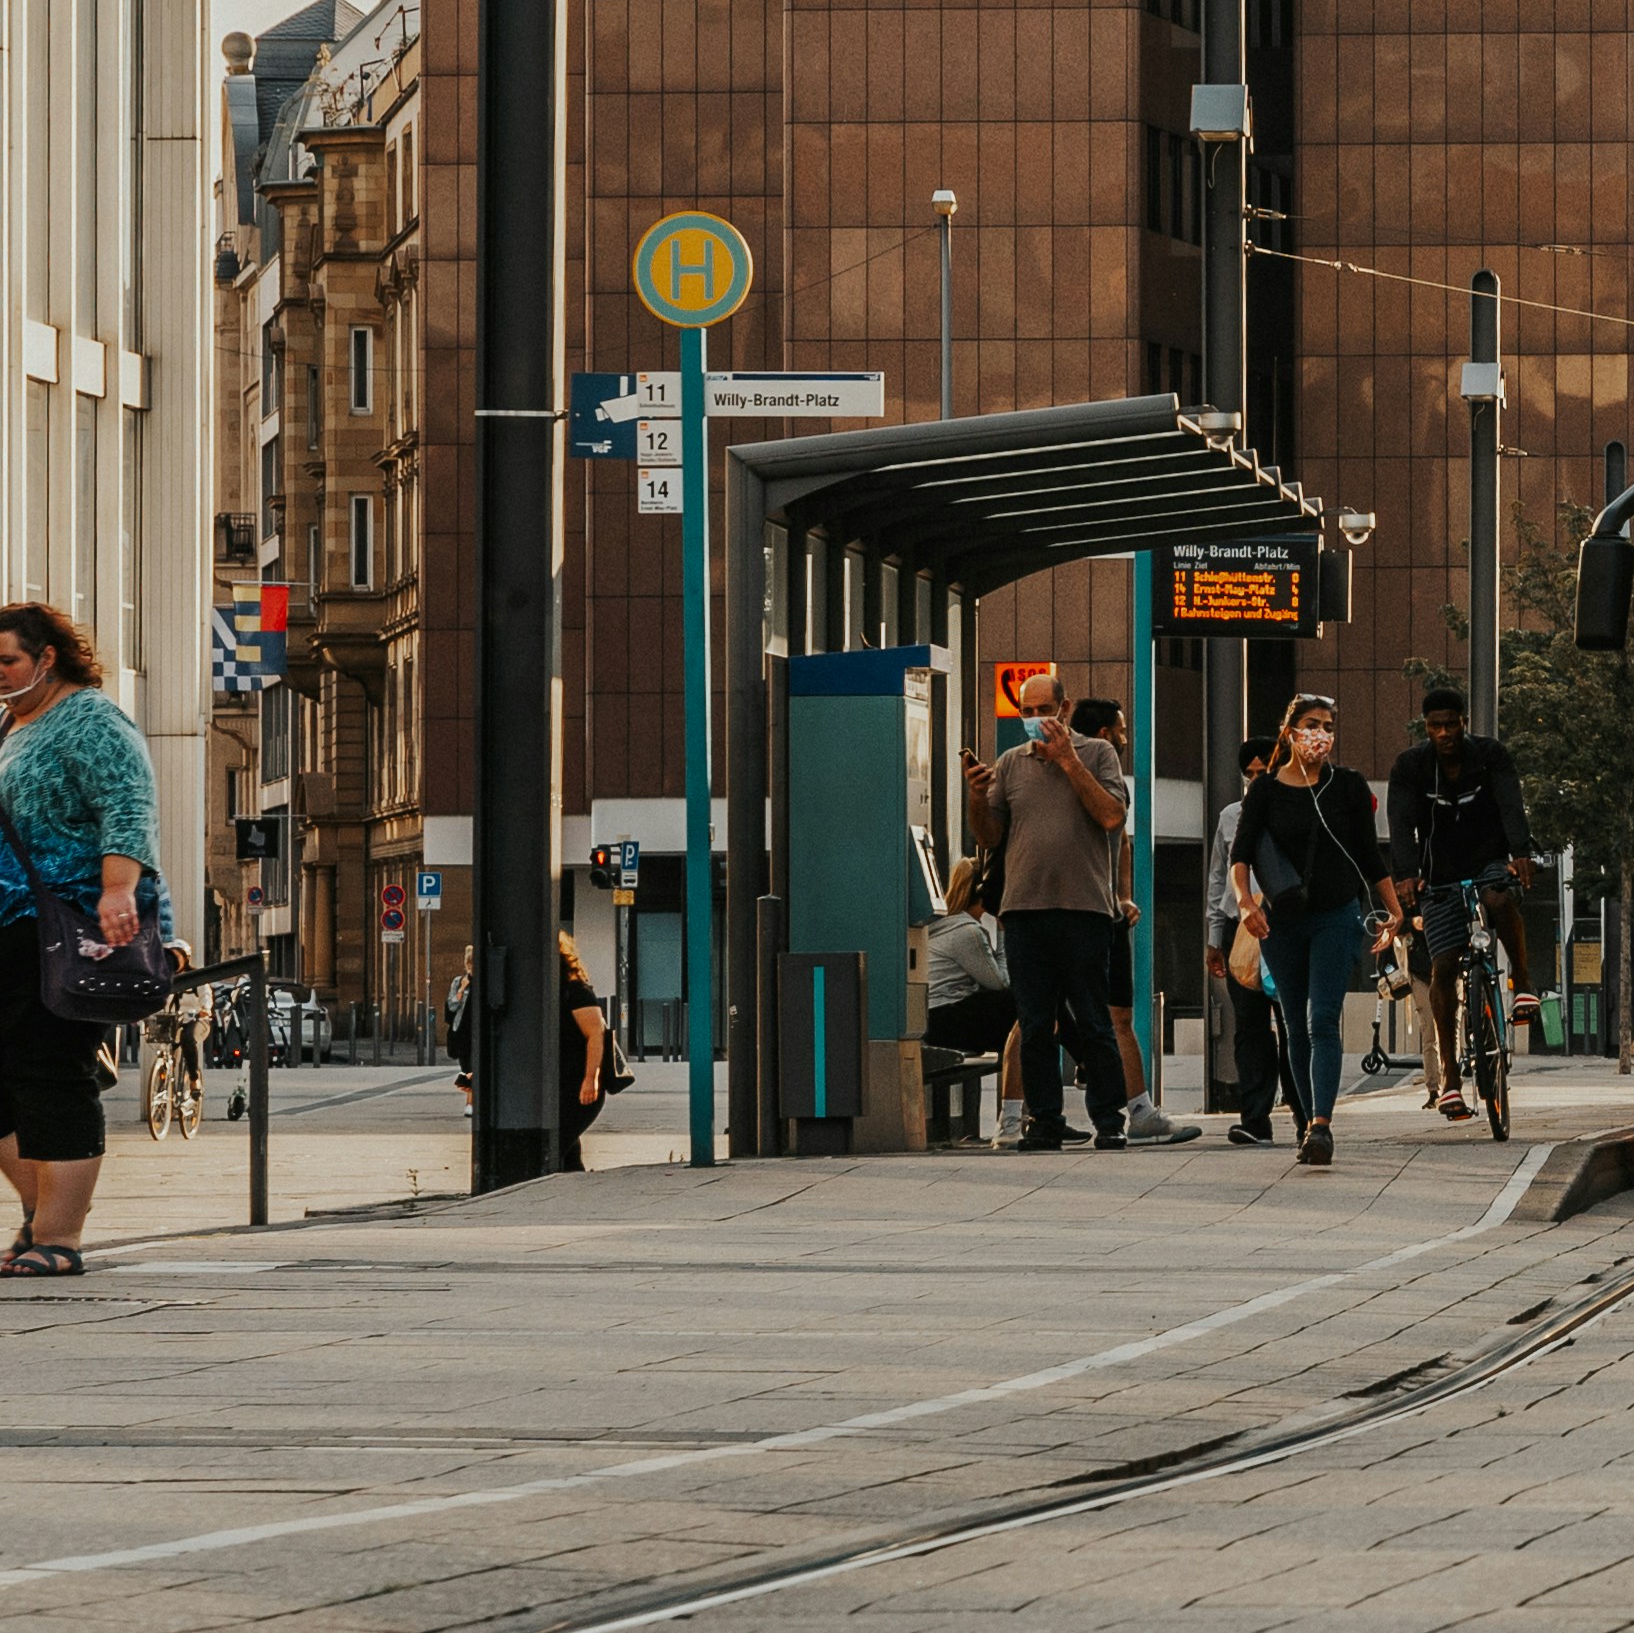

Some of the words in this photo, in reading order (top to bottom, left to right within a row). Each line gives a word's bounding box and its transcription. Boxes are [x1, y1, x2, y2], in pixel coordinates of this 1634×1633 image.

[671, 239, 713, 300] H
[646, 384, 665, 401] 11
[714, 393, 839, 409] Willy-Brandt-Platz
[647, 433, 668, 450] 12
[646, 481, 669, 498] 14
[1173, 545, 1289, 559] Willy-Brandt-Platz
[1174, 571, 1186, 582] 11
[625, 844, 636, 867] P
[422, 875, 436, 894] P
